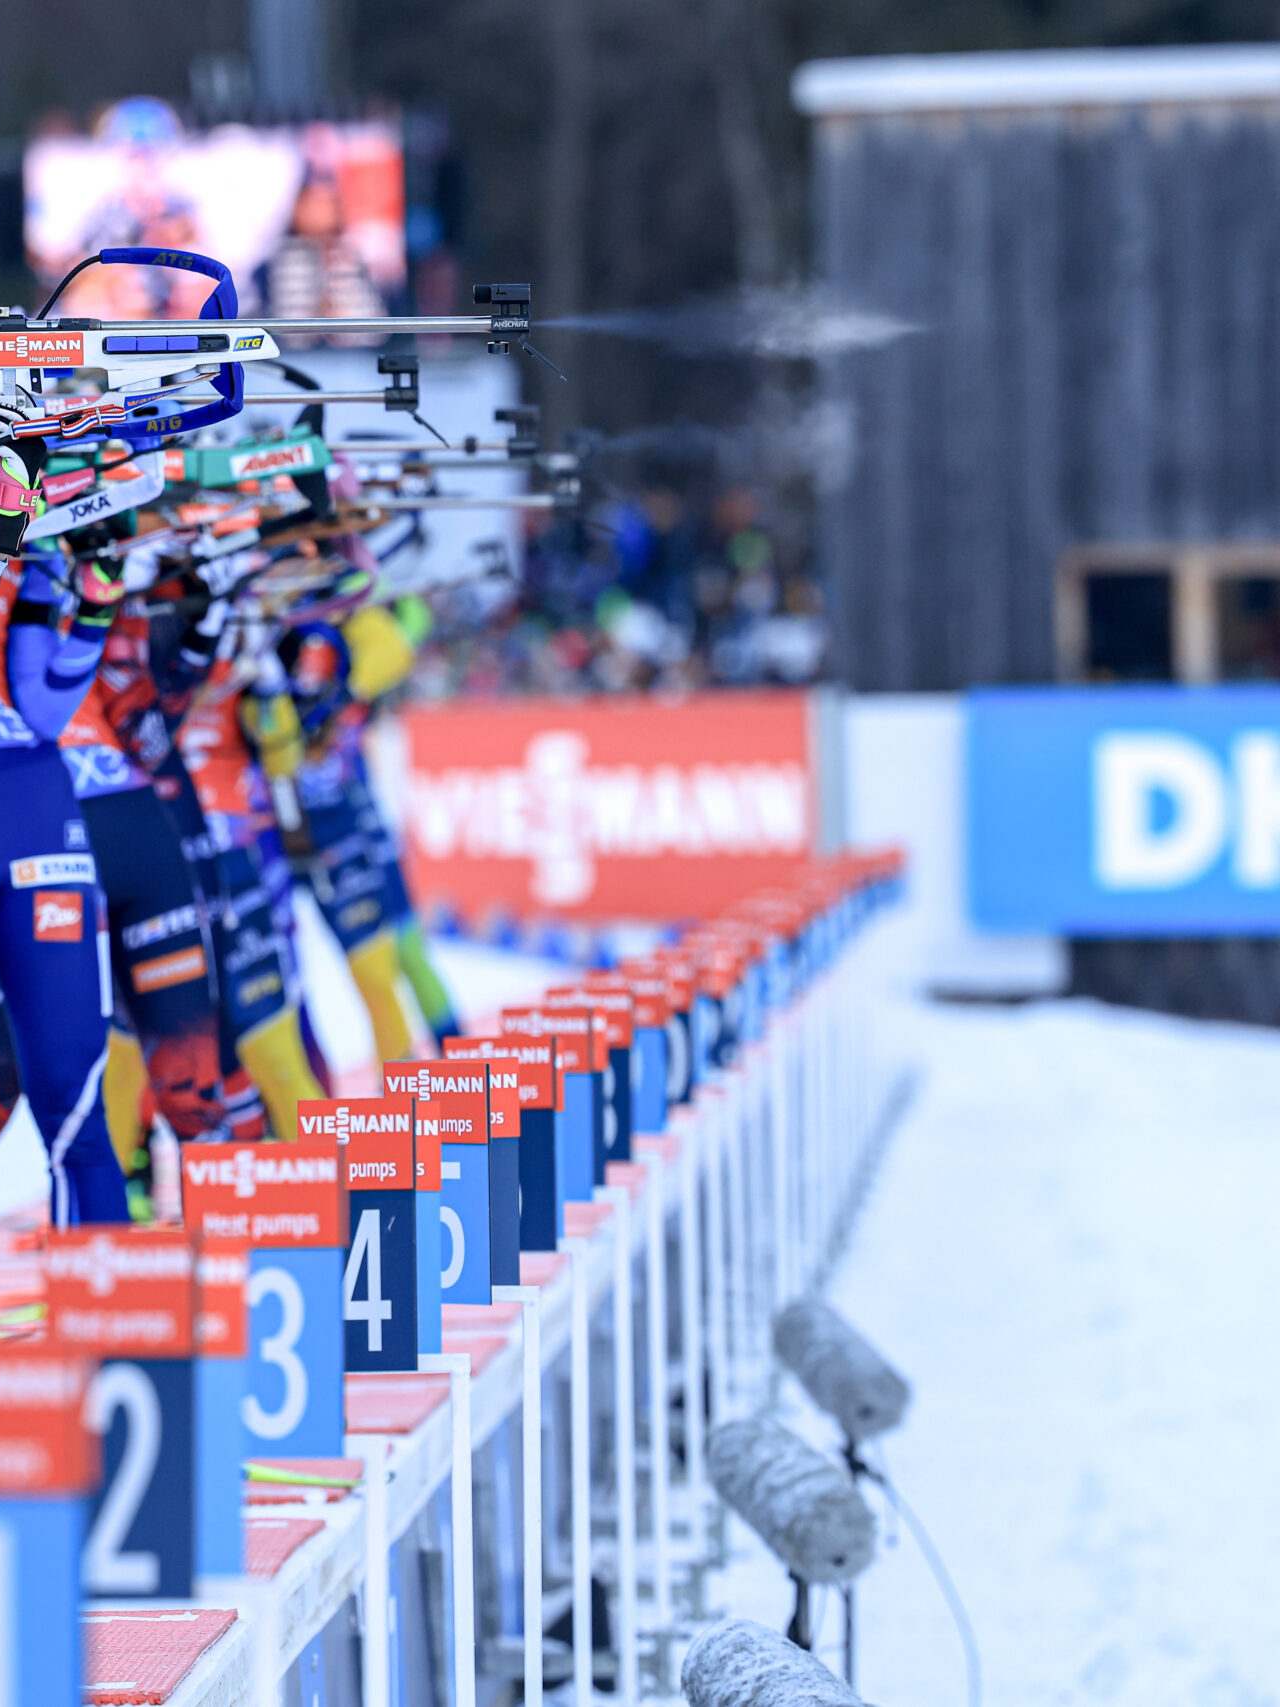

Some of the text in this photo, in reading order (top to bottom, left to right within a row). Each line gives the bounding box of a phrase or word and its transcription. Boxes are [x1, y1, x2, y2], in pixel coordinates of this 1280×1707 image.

[152, 252, 194, 268] ATG
[236, 337, 262, 349] ATG
[146, 416, 182, 432] ATG
[410, 730, 807, 906] VIESSMANN
[386, 1069, 484, 1101] VIESSMANN
[300, 1107, 410, 1145] VIESSMANN
[440, 1118, 473, 1136] umps
[186, 1149, 338, 1198] VIESSMANN
[349, 1162, 397, 1182] pumps
[202, 1213, 320, 1240] Heat pumps
[343, 1209, 392, 1352] 4
[241, 1267, 308, 1440] 3
[83, 1361, 162, 1593] 2
